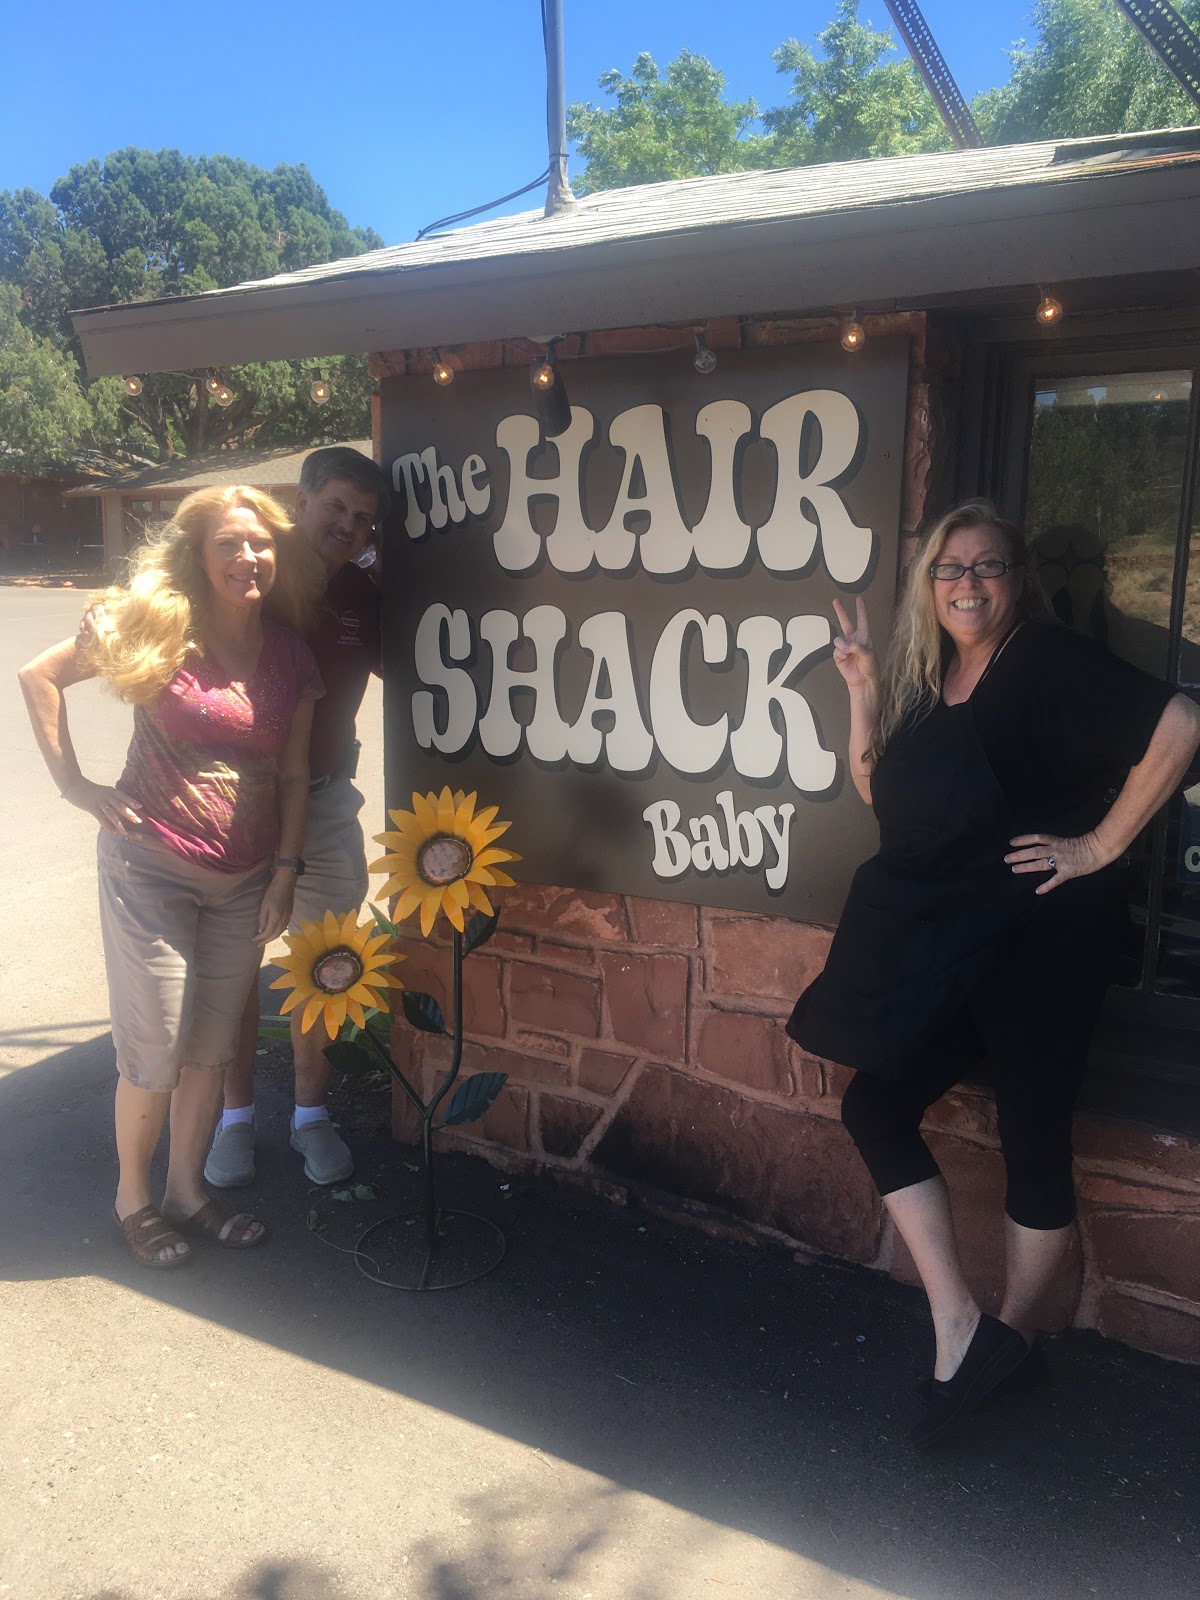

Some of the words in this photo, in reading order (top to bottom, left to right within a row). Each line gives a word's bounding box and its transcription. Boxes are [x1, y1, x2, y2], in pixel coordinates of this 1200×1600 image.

[392, 446, 490, 539] The
[492, 389, 873, 584] HAIR
[411, 603, 837, 792] SHACK
[643, 791, 795, 890] Baby
